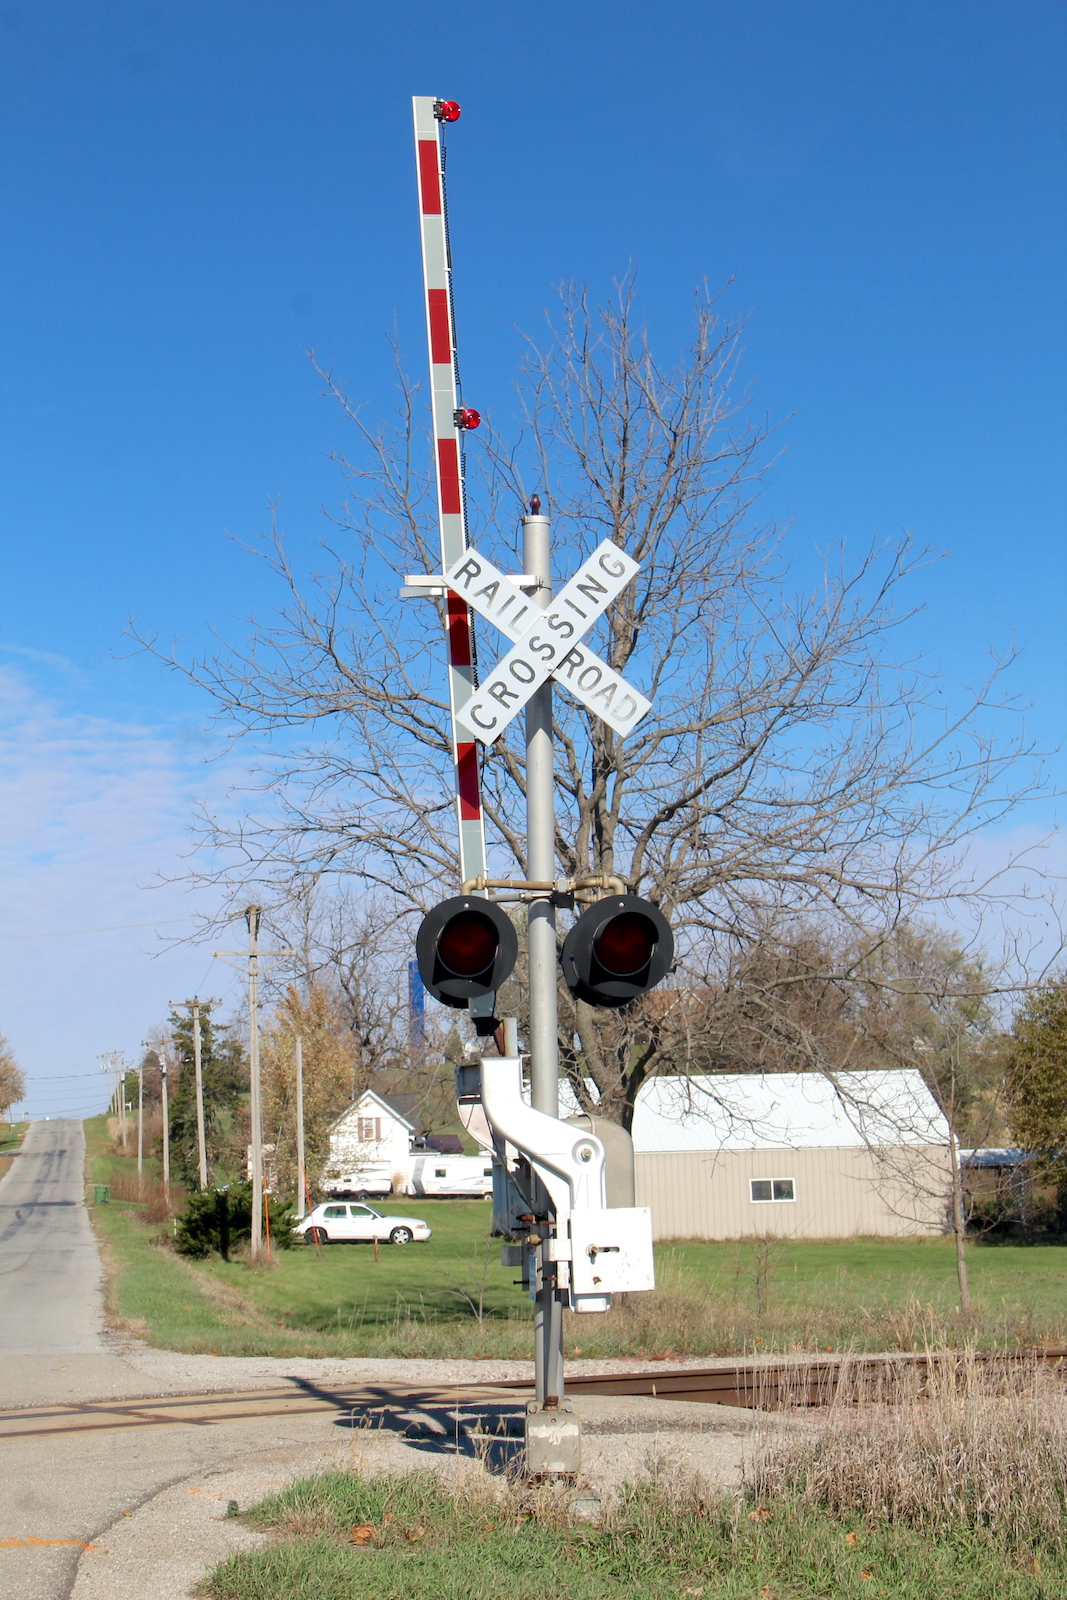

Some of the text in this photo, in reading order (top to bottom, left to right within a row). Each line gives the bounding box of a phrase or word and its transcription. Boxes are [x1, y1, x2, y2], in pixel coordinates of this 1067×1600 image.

[453, 558, 637, 722] RAIL ROAD
[470, 553, 626, 730] CROSSING
